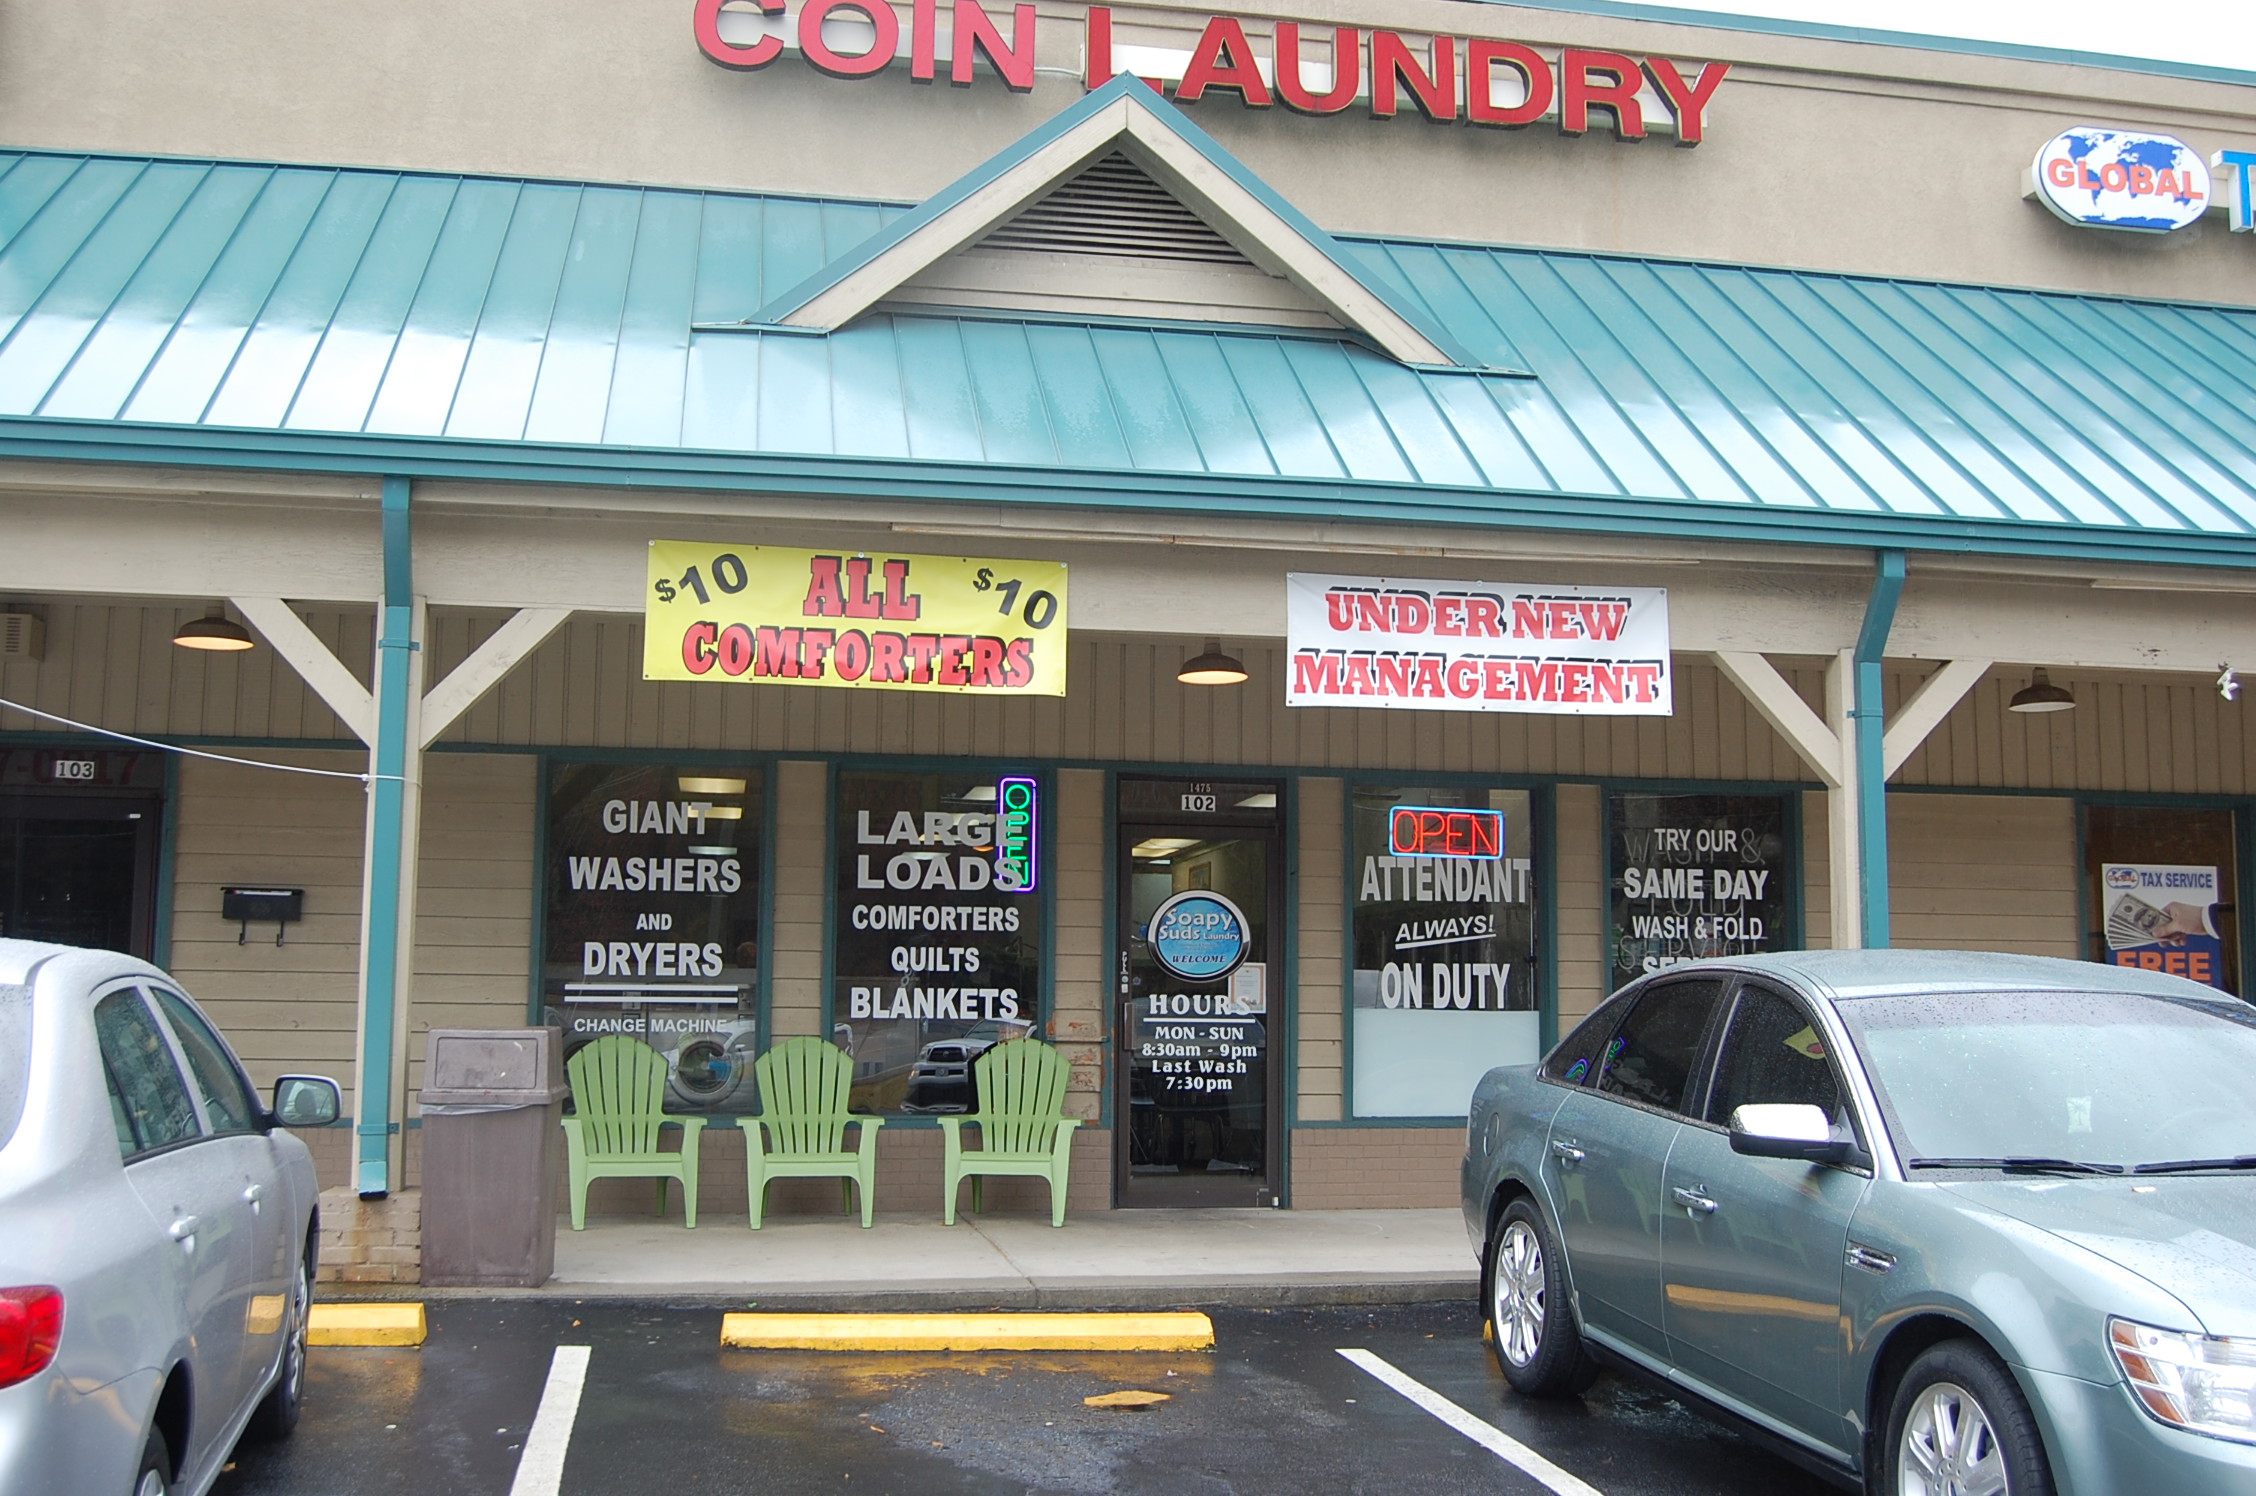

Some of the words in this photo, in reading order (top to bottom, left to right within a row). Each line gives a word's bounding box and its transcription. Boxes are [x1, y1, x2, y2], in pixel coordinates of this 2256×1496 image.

[693, 0, 1037, 93] COIN
[1084, 6, 1732, 146] LAUNDRY
[2048, 158, 2204, 200] GLOBAL
[654, 553, 748, 604] $10
[803, 555, 921, 621] ALL
[973, 567, 1058, 630] $10
[1325, 586, 1507, 639] UNDER
[1512, 594, 1632, 642] NEW
[682, 620, 1034, 688] COMFORTERS
[1293, 648, 1663, 704] MANAGEMENT
[59, 762, 93, 778] 103
[1190, 783, 1212, 793] 1475
[603, 800, 713, 835] GIANT
[1184, 796, 1214, 811] 102
[857, 810, 1024, 847] LARGE
[1392, 810, 1498, 855] OPEN
[1654, 829, 1691, 851] TRY
[1696, 830, 1737, 852] OUR
[569, 857, 741, 893] WASHERS
[857, 855, 1022, 892] LOADS
[1360, 856, 1531, 902] ATTENDANT
[1624, 868, 1704, 898] SAME
[1714, 870, 1769, 900] DAY
[2141, 872, 2163, 887] TAX
[2165, 873, 2213, 888] SERVICE
[636, 913, 672, 931] AND
[852, 904, 1020, 932] COMFORTERS
[1166, 908, 1233, 930] Soapy
[1395, 915, 1494, 942] ALWAYS!
[1632, 916, 1688, 939] WASH
[1694, 917, 1707, 939] &
[1713, 917, 1763, 939] FOLD
[1159, 925, 1201, 940] Suds
[1204, 933, 1240, 941] Laundry
[584, 942, 723, 977] DRYERS
[891, 946, 980, 972] QUILTS
[1172, 955, 1226, 963] WELCOME
[2117, 951, 2211, 980] FREE
[1381, 962, 1422, 1009] ON
[1433, 963, 1510, 1009] DUTY
[851, 987, 1019, 1020] BLANKETS
[1149, 994, 1251, 1016] HOURS
[574, 1018, 646, 1033] CHANGE
[651, 1019, 728, 1033] MACHINE
[1155, 1027, 1195, 1040] MON
[1209, 1027, 1244, 1040] SUN
[1142, 1043, 1201, 1057] 8:30am
[1219, 1044, 1257, 1060] 9pm
[1152, 1059, 1191, 1073] Last
[1199, 1059, 1247, 1073] Wash
